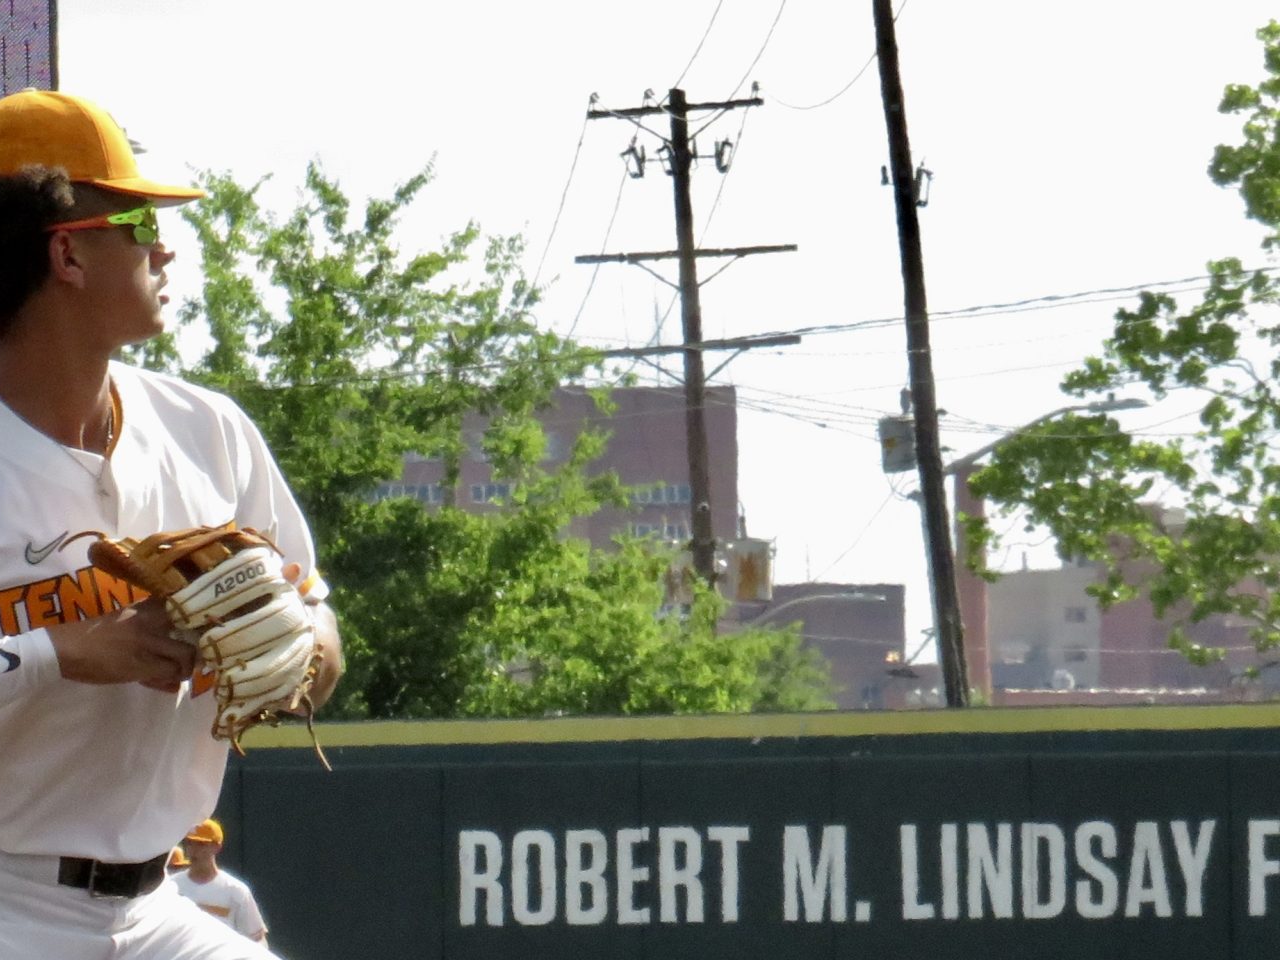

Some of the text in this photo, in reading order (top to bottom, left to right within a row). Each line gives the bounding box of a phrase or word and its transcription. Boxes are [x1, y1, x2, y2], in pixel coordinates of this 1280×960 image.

[214, 560, 267, 598] A2000
[458, 824, 751, 926] ROBERT
[782, 824, 872, 924] M.
[900, 818, 1217, 921] LINDSAY
